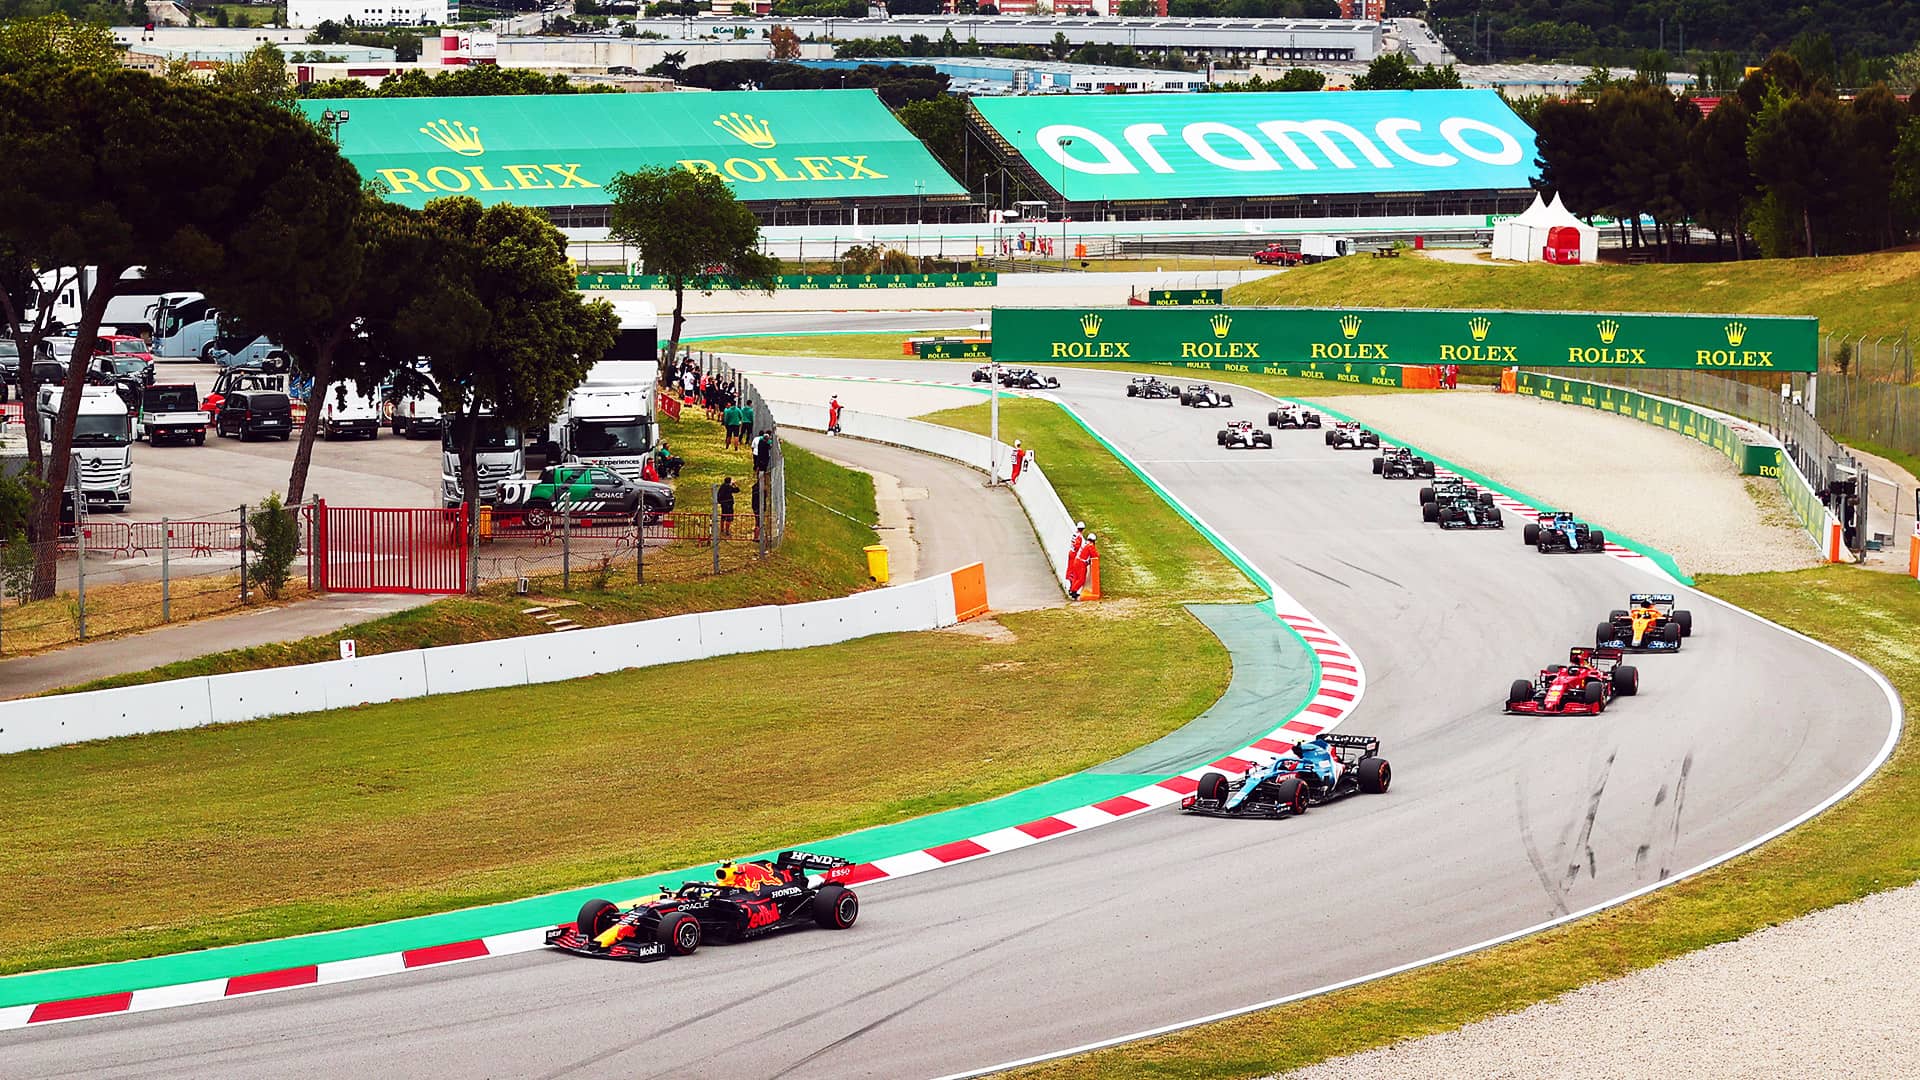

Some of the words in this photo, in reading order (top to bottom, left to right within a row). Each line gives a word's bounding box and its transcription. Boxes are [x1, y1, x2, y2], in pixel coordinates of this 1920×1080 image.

[1036, 117, 1523, 174] aramco
[376, 164, 601, 194] ROLEX
[677, 155, 888, 184] ROLEX
[927, 351, 950, 359] ROLEX
[963, 350, 986, 358] ROLEX
[1052, 342, 1130, 358] ROLEX
[1181, 342, 1260, 358] ROLEX
[1311, 343, 1389, 359] ROLEX
[1440, 345, 1518, 361] ROLEX
[1568, 347, 1646, 364] ROLEX
[1696, 350, 1774, 367] ROLEX
[1225, 364, 1249, 372] ROLEX
[1263, 366, 1288, 376] ROLEX
[1301, 369, 1324, 380] ROLEX
[1337, 372, 1360, 383] ROLEX
[1372, 375, 1395, 387] ROLEX
[599, 458, 640, 467] Experiences
[790, 851, 839, 865] HOND
[771, 886, 802, 899] HONDA
[677, 901, 709, 912] ORACLE
[640, 942, 658, 957] Mobil
